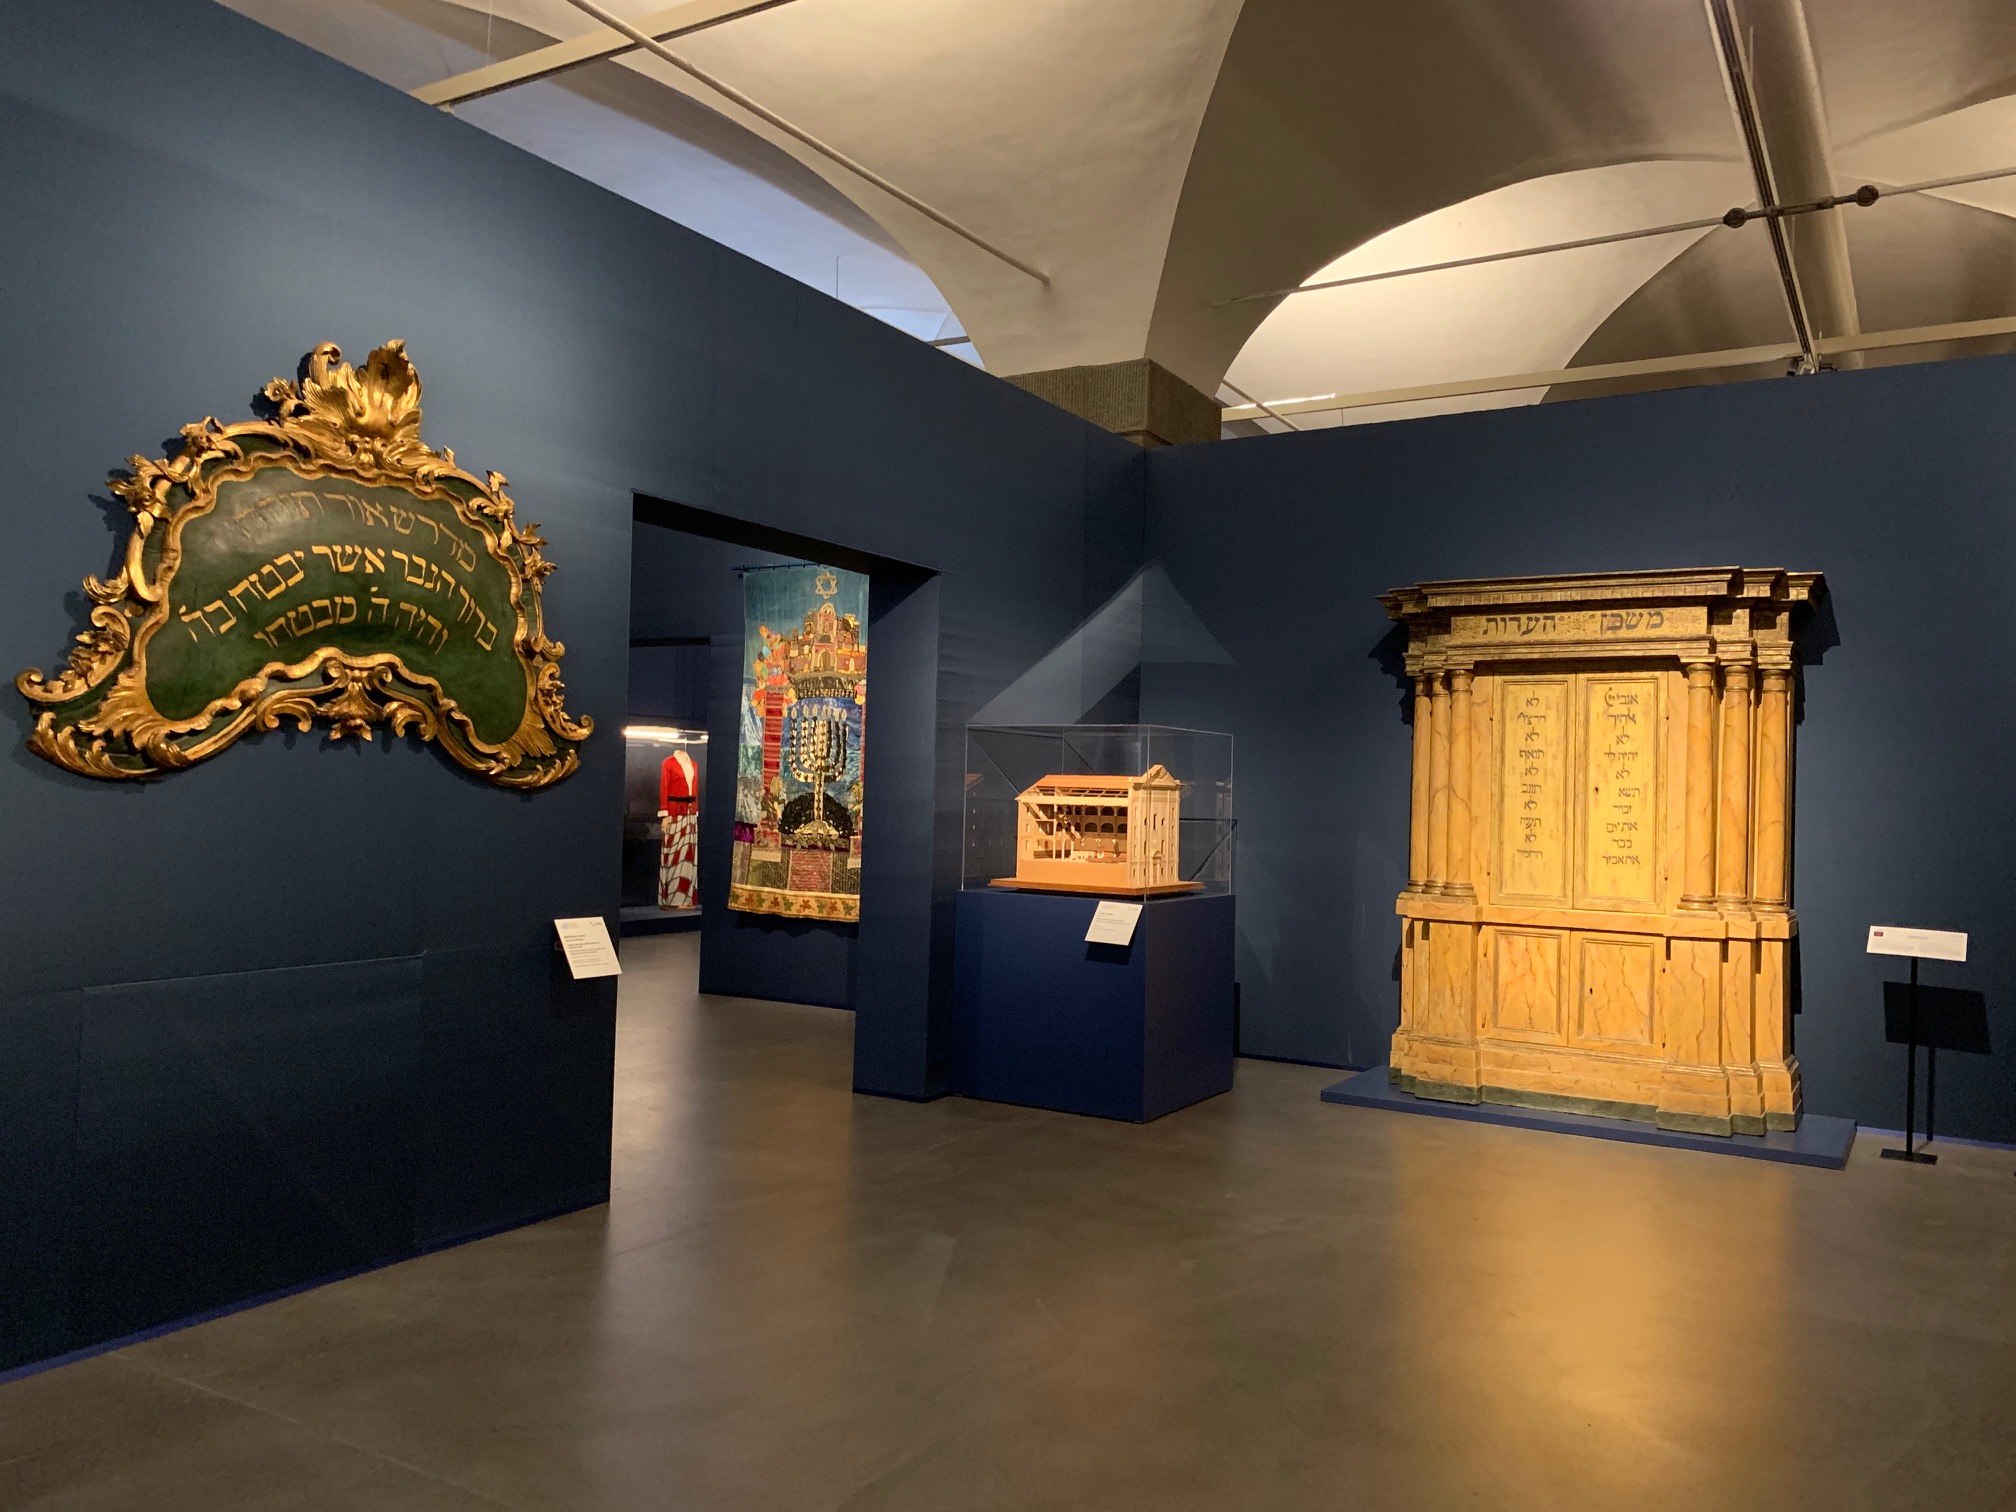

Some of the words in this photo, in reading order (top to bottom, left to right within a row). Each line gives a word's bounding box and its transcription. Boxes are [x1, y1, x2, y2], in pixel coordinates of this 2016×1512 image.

[323, 492, 389, 528] אור
[389, 504, 476, 573] מדרש
[311, 544, 386, 574] אשר
[228, 550, 305, 613] יבטח
[391, 549, 456, 599] הגבר
[253, 596, 357, 650] מבטחו
[394, 601, 448, 655] והיה
[457, 585, 497, 651] ברוך
[1482, 615, 1556, 637] העדות
[1600, 610, 1664, 636] משכן
[1525, 690, 1540, 708] לא
[1525, 726, 1540, 742] לא
[1615, 726, 1630, 745] לא
[1525, 761, 1539, 777] לא
[1615, 761, 1630, 780] לא
[1523, 795, 1538, 810] לא
[1524, 828, 1537, 843] לא
